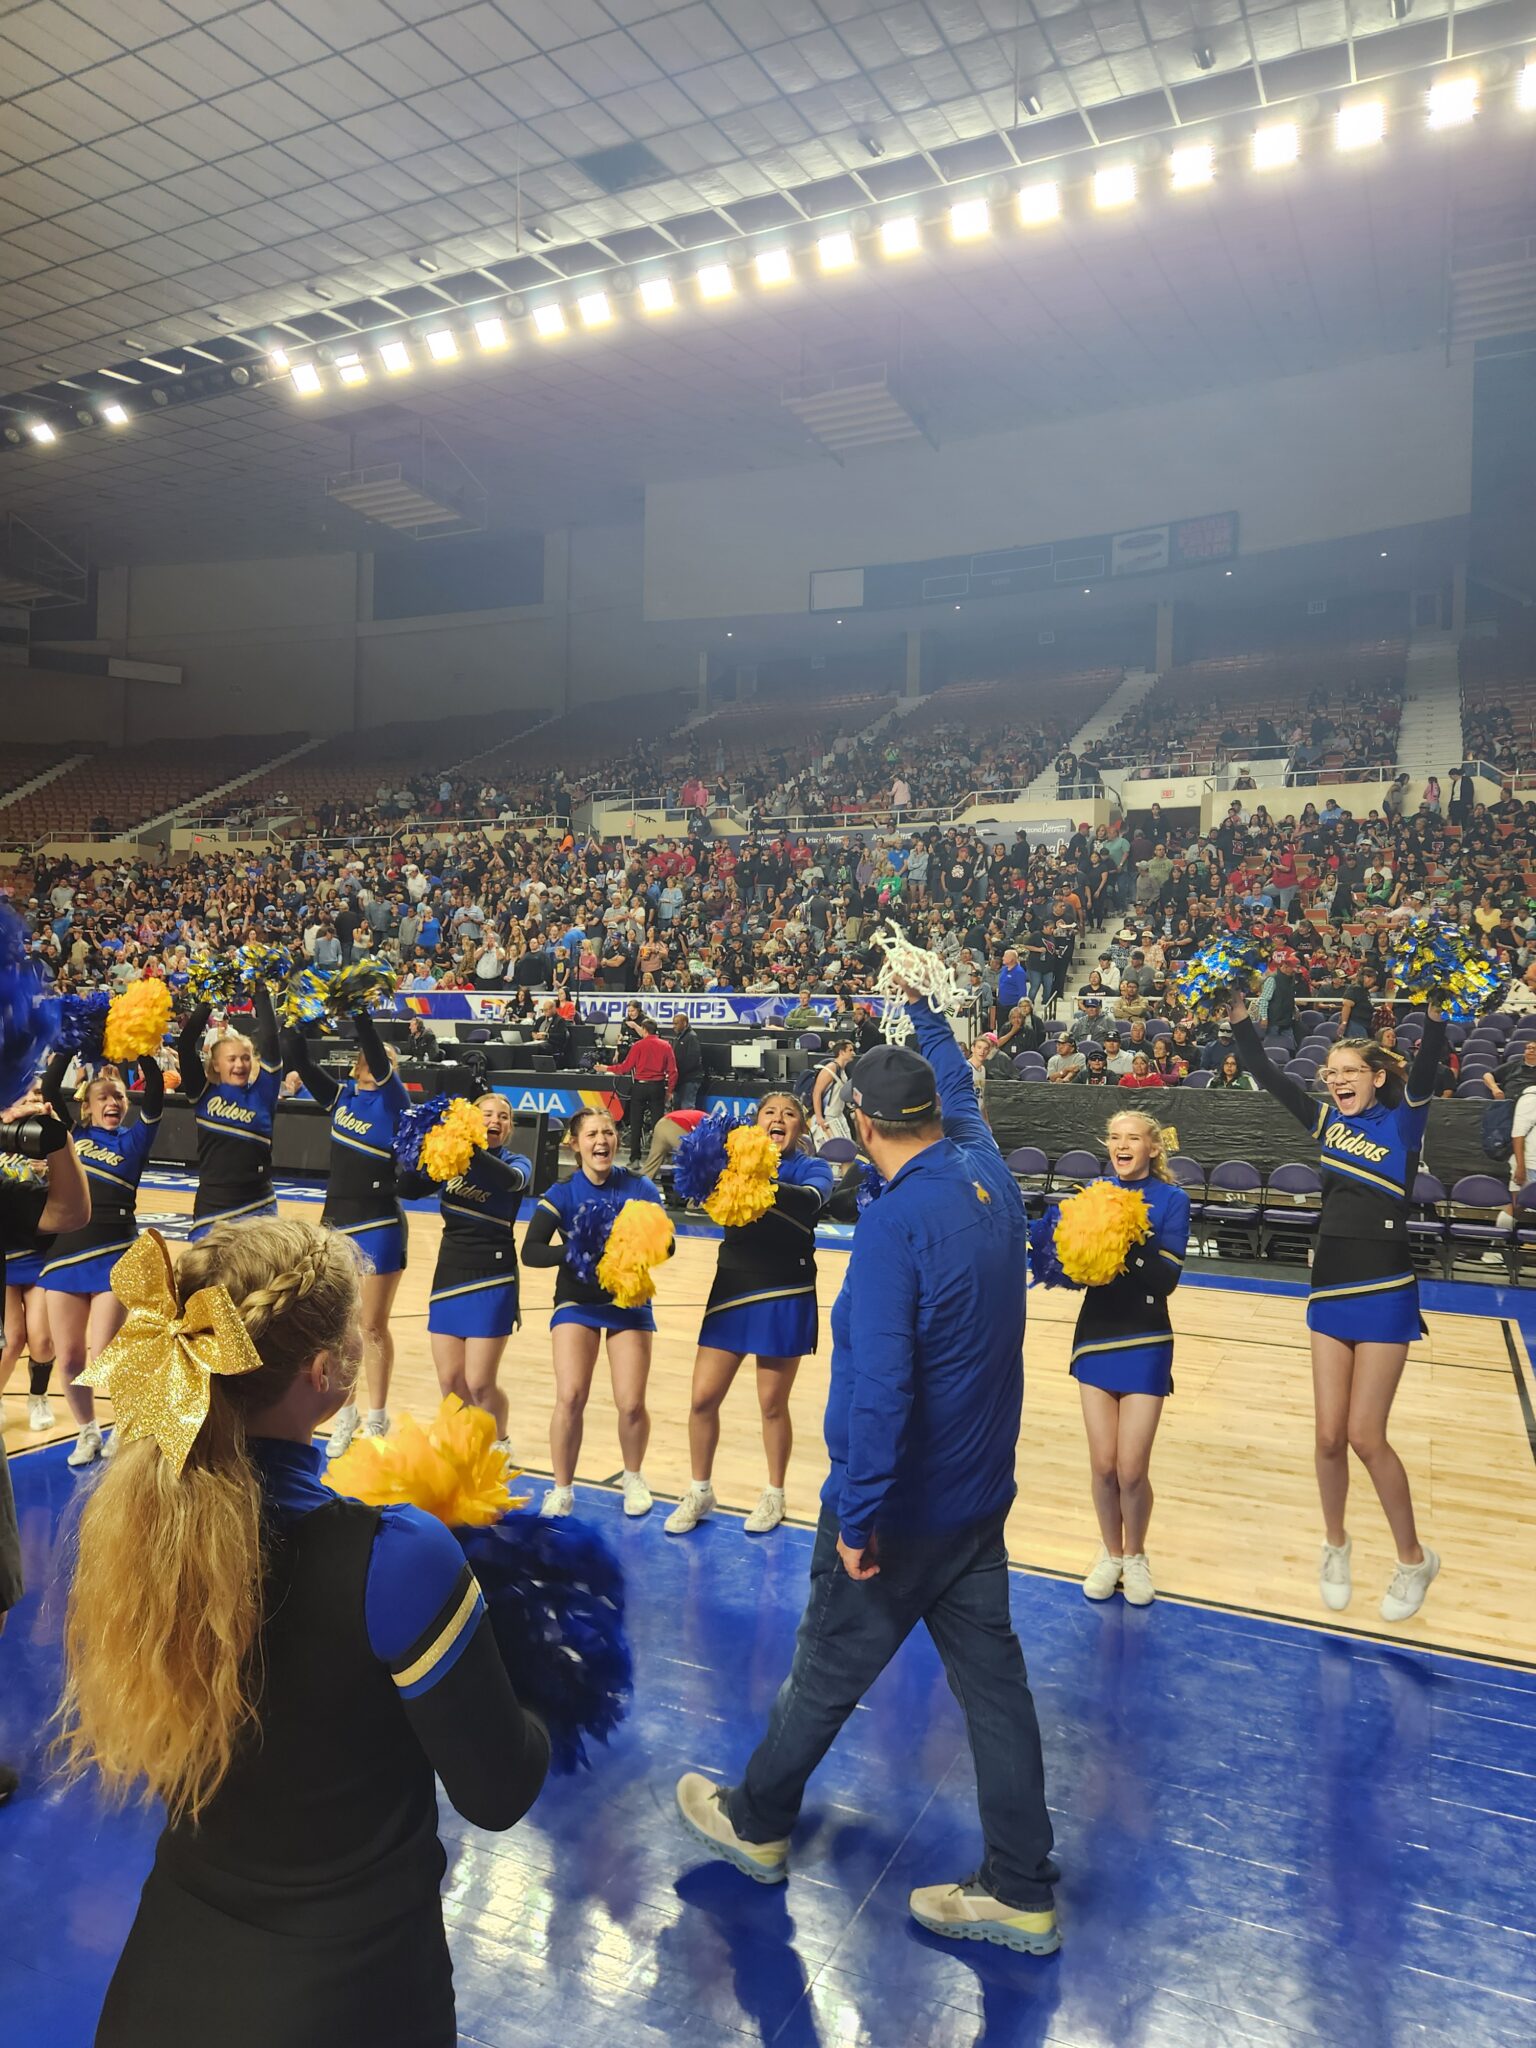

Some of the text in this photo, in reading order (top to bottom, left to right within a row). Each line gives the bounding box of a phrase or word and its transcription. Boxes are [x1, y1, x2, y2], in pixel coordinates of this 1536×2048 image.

[1186, 785, 1197, 798] 5
[207, 1095, 257, 1124] Riders
[518, 1091, 566, 1114] AIA
[334, 1105, 373, 1135] Riders
[74, 1138, 125, 1166] Riders
[1325, 1122, 1390, 1162] Riders
[445, 1175, 492, 1203] Riders
